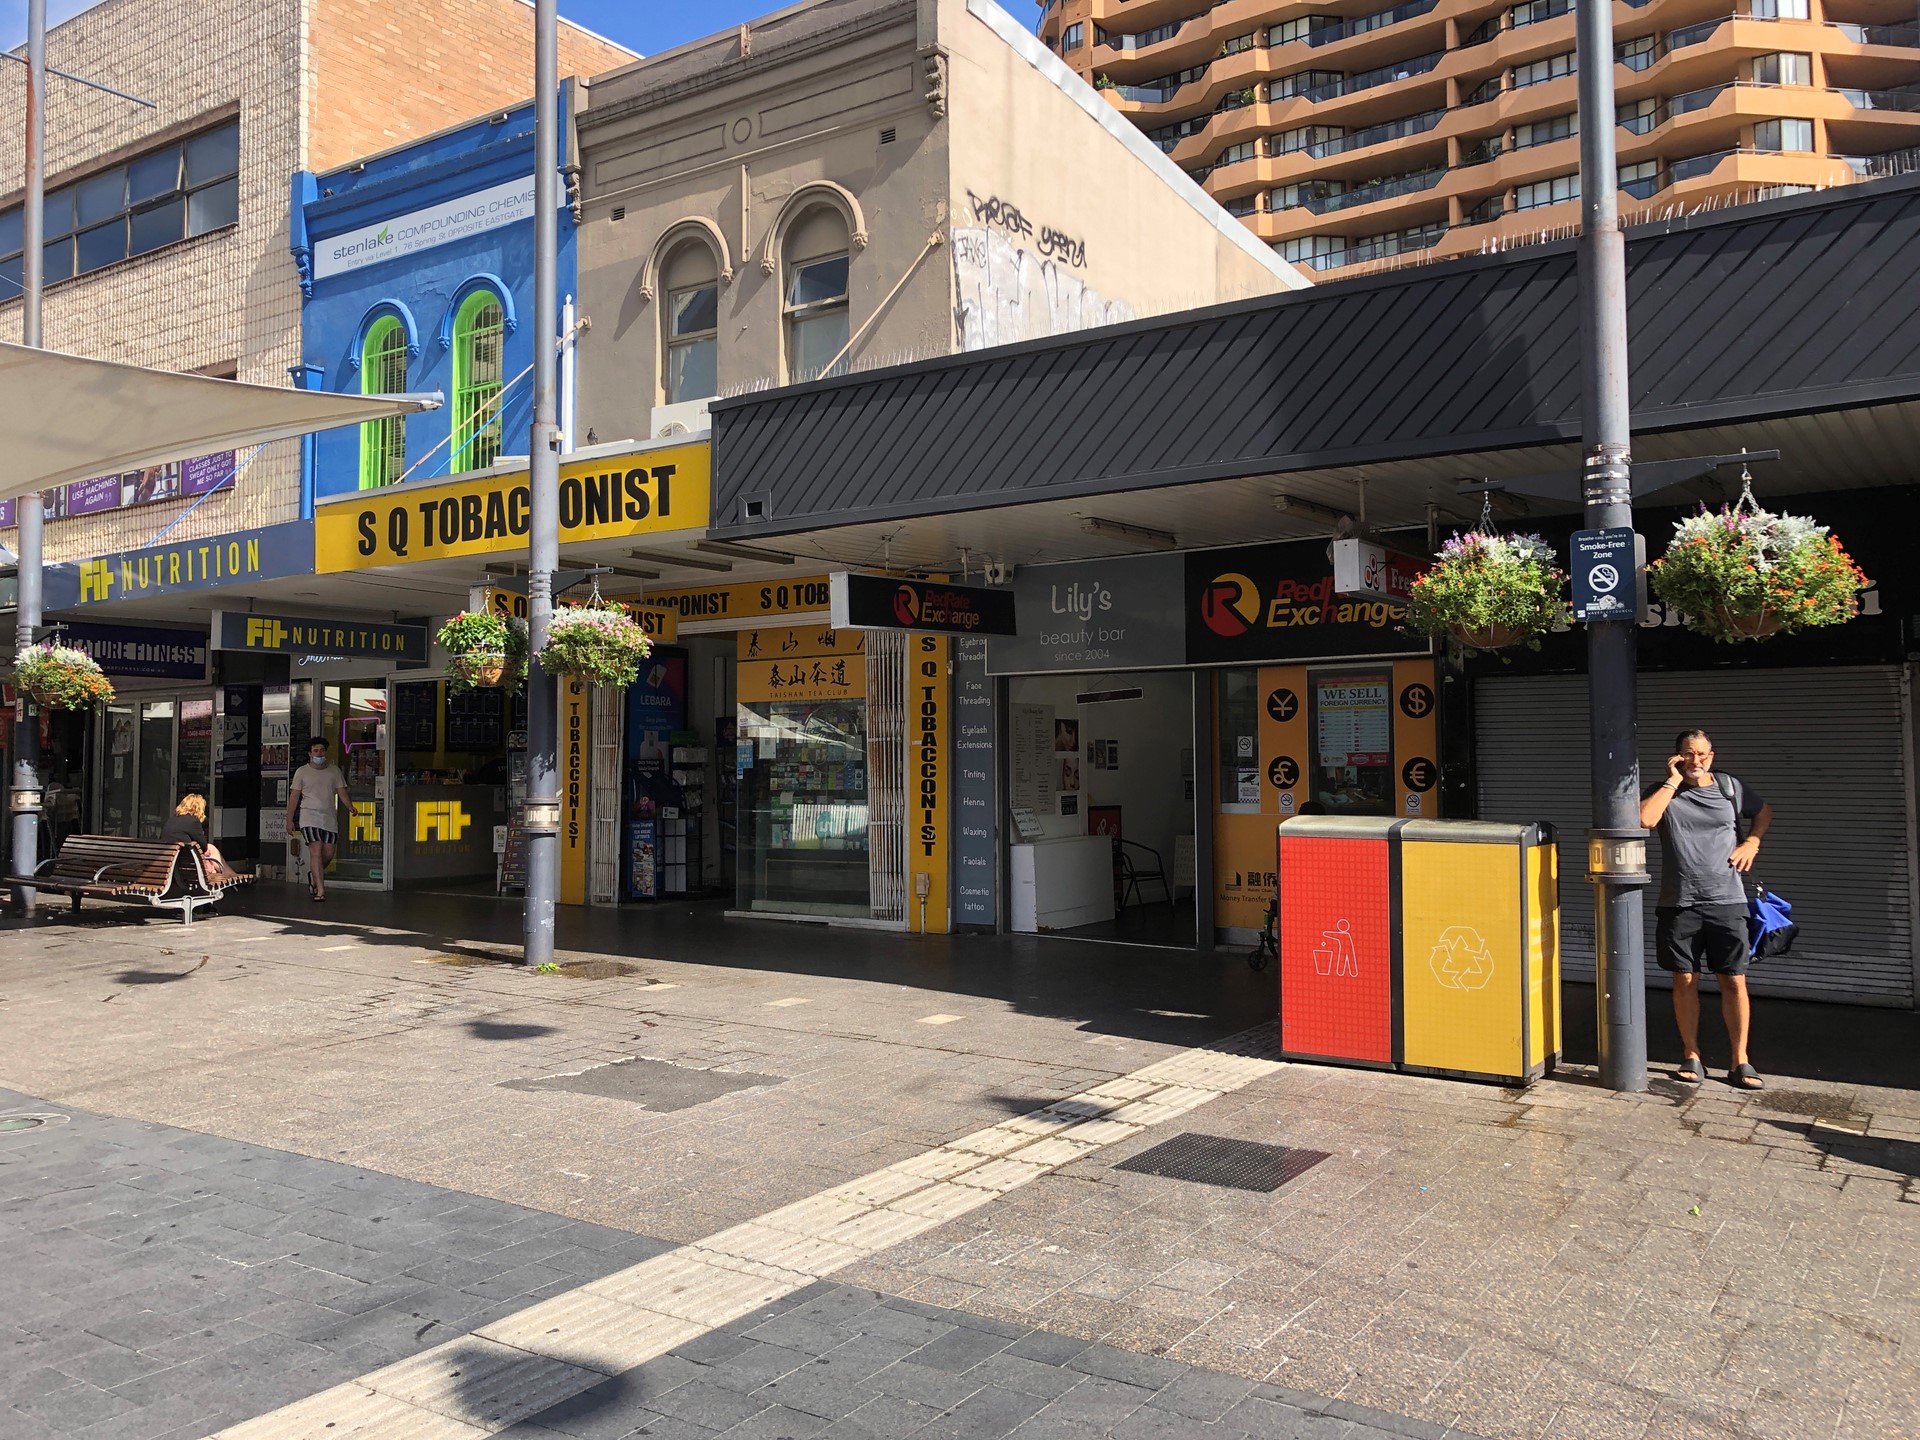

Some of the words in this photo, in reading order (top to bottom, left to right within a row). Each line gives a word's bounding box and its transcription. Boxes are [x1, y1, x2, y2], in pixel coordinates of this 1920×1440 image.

[333, 231, 394, 260] stenlake
[398, 206, 486, 241] COMPOUNDING
[489, 190, 535, 213] CHEMIS
[348, 256, 364, 268] Entry
[376, 248, 392, 260] Level
[404, 242, 413, 250] 76
[414, 234, 436, 249] Spring
[438, 230, 446, 240] St
[448, 222, 482, 238] OPPOSITE
[485, 208, 524, 228] EASTGATE
[188, 459, 210, 473] CLASSES
[212, 454, 224, 464] JUST
[189, 468, 206, 480] SWEAT
[207, 463, 220, 473] ONLY
[221, 458, 232, 468] GOT
[197, 477, 204, 486] ME
[214, 470, 224, 478] FAR
[72, 490, 84, 501] USE
[85, 477, 117, 495] MACHINES
[85, 492, 104, 506] AGAIN
[358, 510, 376, 556] S
[388, 507, 408, 556] Q
[420, 464, 676, 547] TOBACONIST
[1580, 541, 1626, 551] Smoke-Free
[123, 540, 260, 591] NUTRITION
[1391, 567, 1410, 591] Fre
[760, 588, 772, 610] S
[778, 586, 789, 610] Q
[926, 590, 970, 609] RedRate
[1051, 582, 1112, 620] Lily's
[922, 602, 979, 629] Exchange
[1267, 598, 1406, 628] Exchange
[292, 626, 404, 651] NUTRITION
[921, 636, 936, 652] S
[1040, 630, 1093, 650] beauty
[1098, 626, 1126, 642] bar
[136, 644, 195, 663] FITNESS
[958, 652, 985, 661] Threadin
[1054, 650, 1081, 661] since
[1084, 648, 1110, 660] 2004
[768, 659, 851, 689] 泰山茶道
[921, 661, 936, 678] Q
[966, 681, 982, 690] Face
[1324, 689, 1346, 699] WE
[1349, 688, 1381, 699] SELL
[641, 696, 672, 706] LEBARA
[959, 696, 990, 706] Threading
[225, 722, 247, 731] TAX
[270, 724, 288, 737] TAX
[962, 725, 988, 736] Eyelash
[957, 740, 992, 749] Extensions
[568, 702, 582, 848] TOBACCONIST
[920, 686, 937, 857] TOBACCONIST
[963, 770, 986, 780] Tinting
[963, 797, 984, 806] Henna
[963, 826, 987, 838] Waxing
[963, 856, 986, 866] Facials
[960, 886, 989, 896] Cosmetic
[964, 902, 985, 911] tattoo
